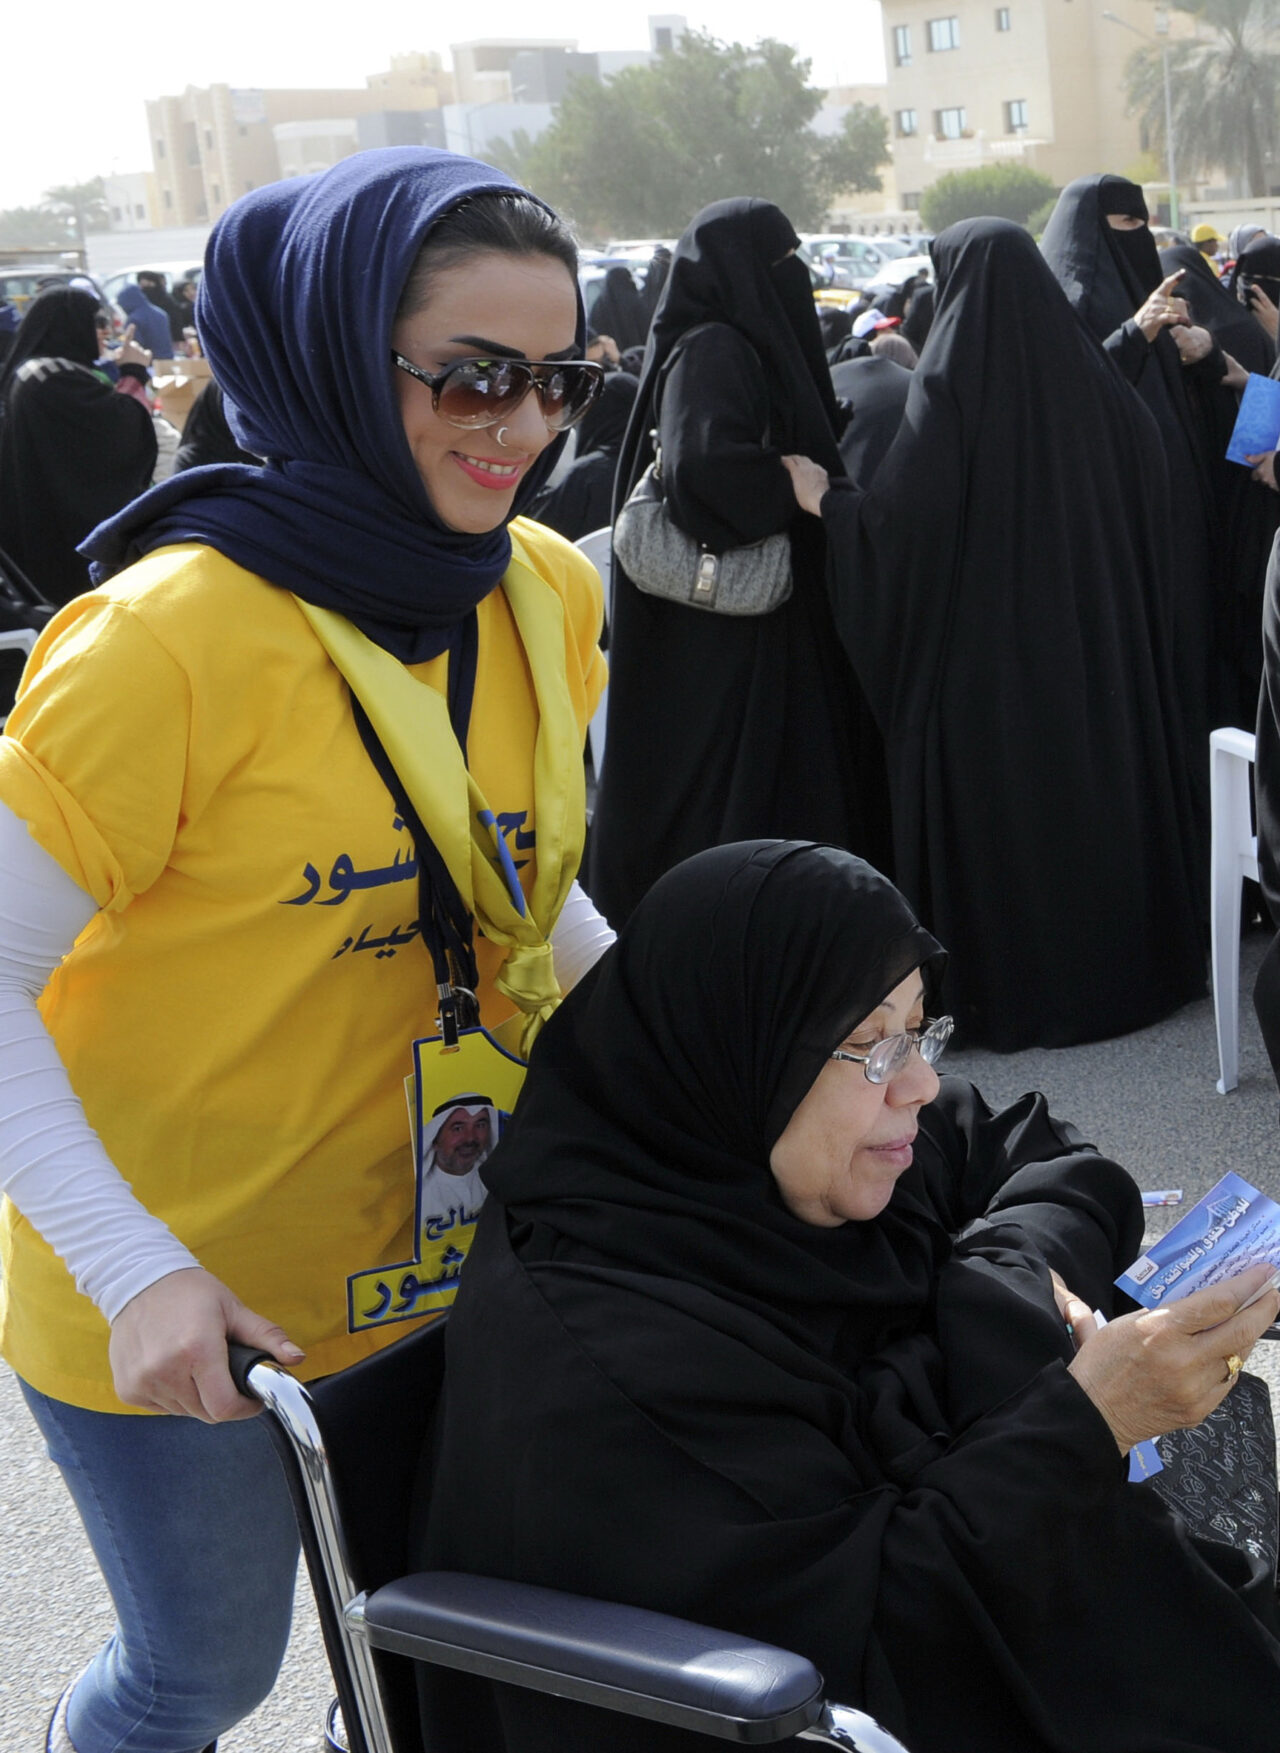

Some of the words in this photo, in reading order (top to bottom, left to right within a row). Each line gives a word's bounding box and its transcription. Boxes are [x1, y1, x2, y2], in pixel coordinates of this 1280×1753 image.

[278, 802, 419, 906] شور
[1225, 1198, 1250, 1228] للوطن
[1203, 1224, 1226, 1250] حقوق
[1163, 1243, 1206, 1285] وللمواطنة
[363, 1246, 465, 1319] شور
[1150, 1283, 1166, 1300] حق
